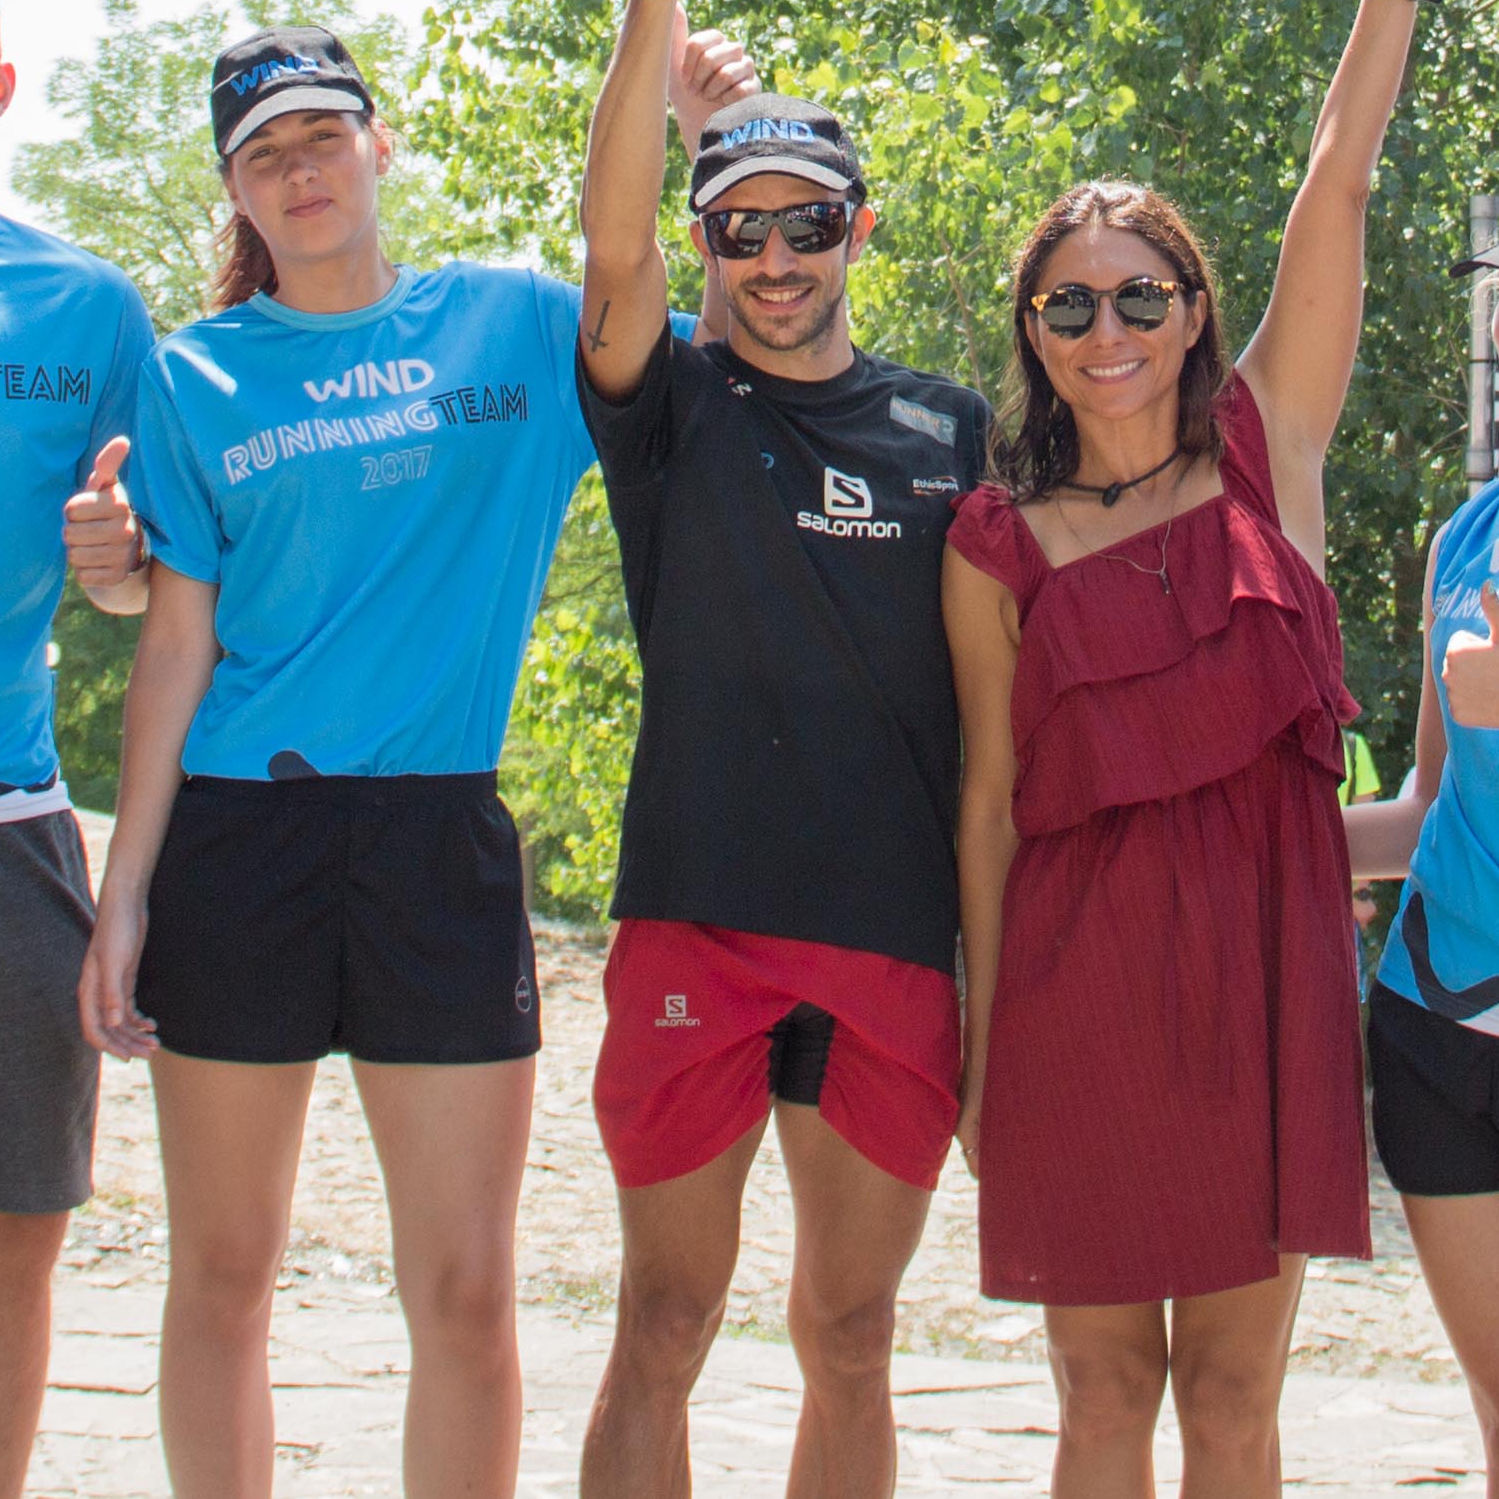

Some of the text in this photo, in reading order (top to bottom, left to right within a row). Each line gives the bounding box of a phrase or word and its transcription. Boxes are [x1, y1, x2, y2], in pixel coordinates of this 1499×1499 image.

[229, 54, 320, 97] WIND
[721, 117, 815, 151] WIND
[303, 358, 436, 403] WIND
[360, 444, 433, 491] 2017
